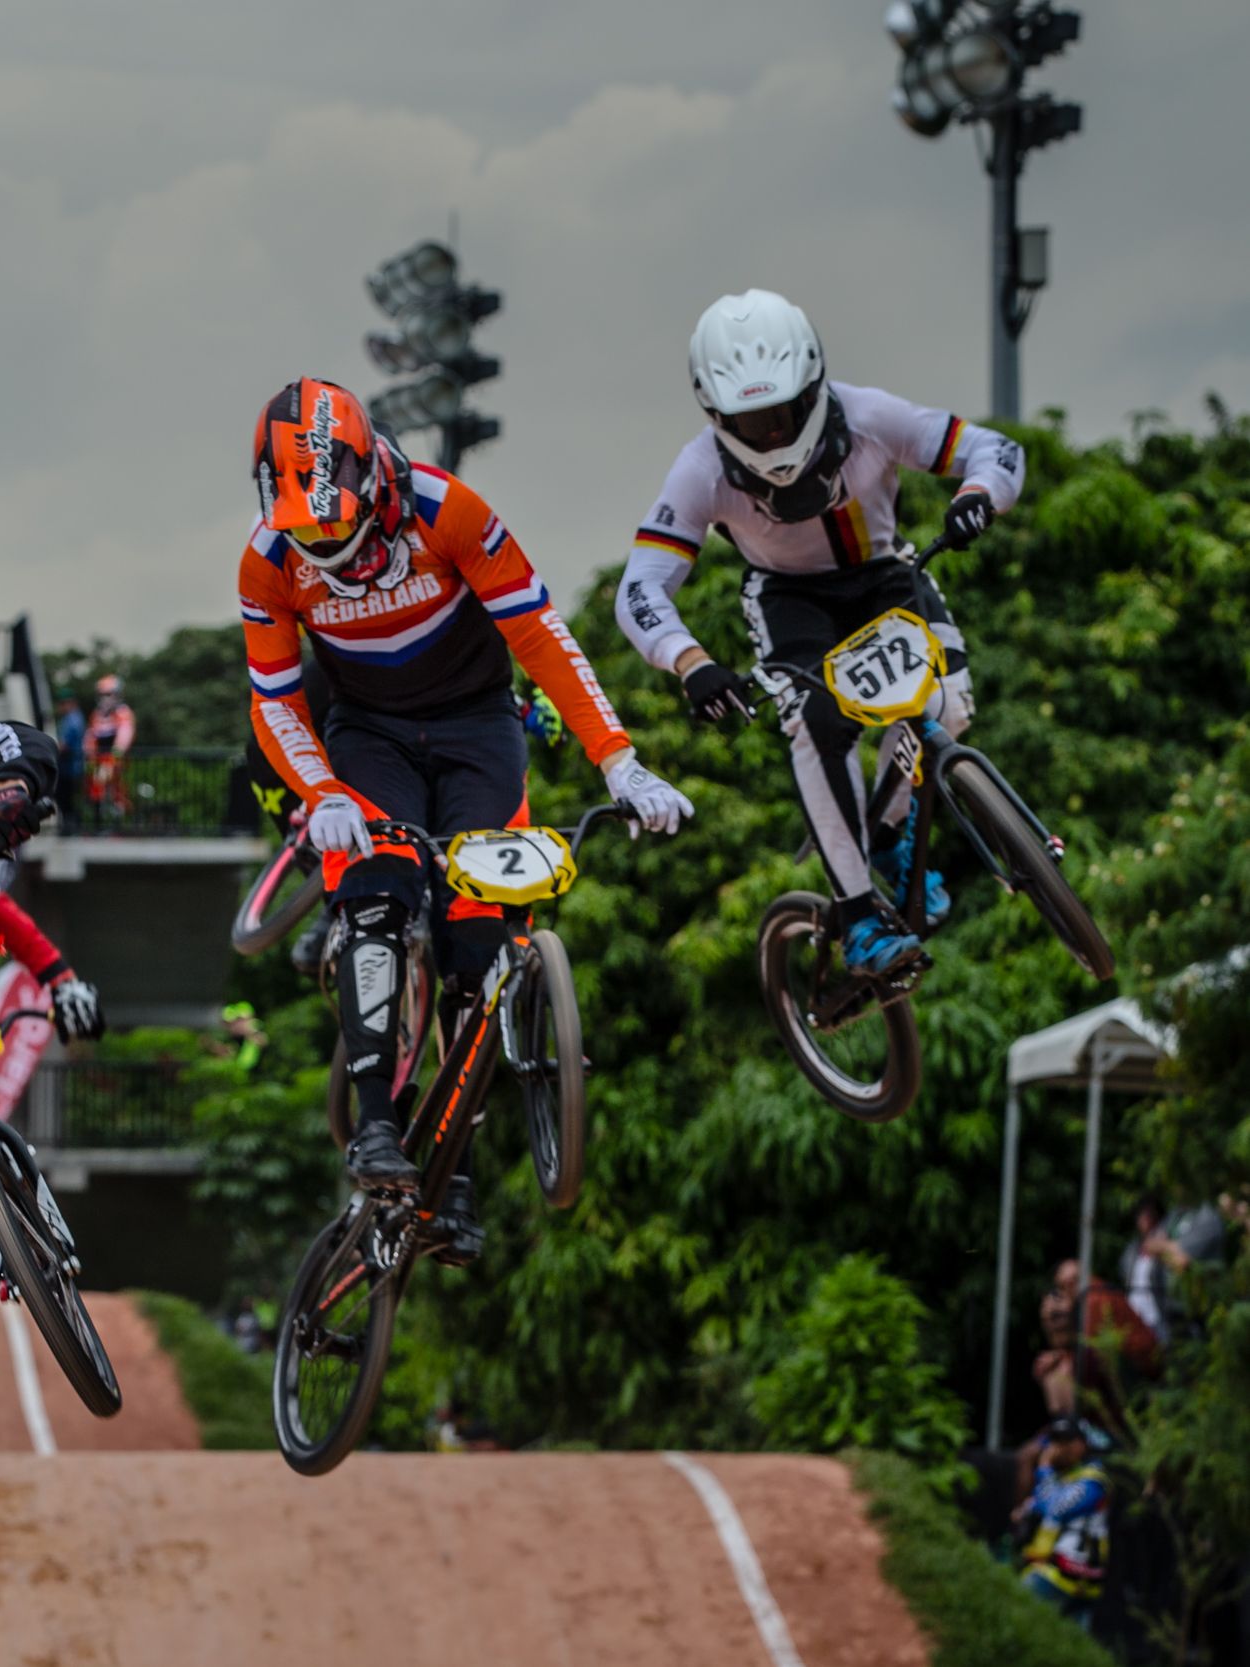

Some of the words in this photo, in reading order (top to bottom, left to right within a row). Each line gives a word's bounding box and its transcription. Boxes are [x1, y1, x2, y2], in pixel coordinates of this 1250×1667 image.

[305, 482, 339, 518] Troy
[312, 573, 442, 625] NEDERLAND
[845, 636, 923, 700] 572
[496, 847, 526, 876] 2
